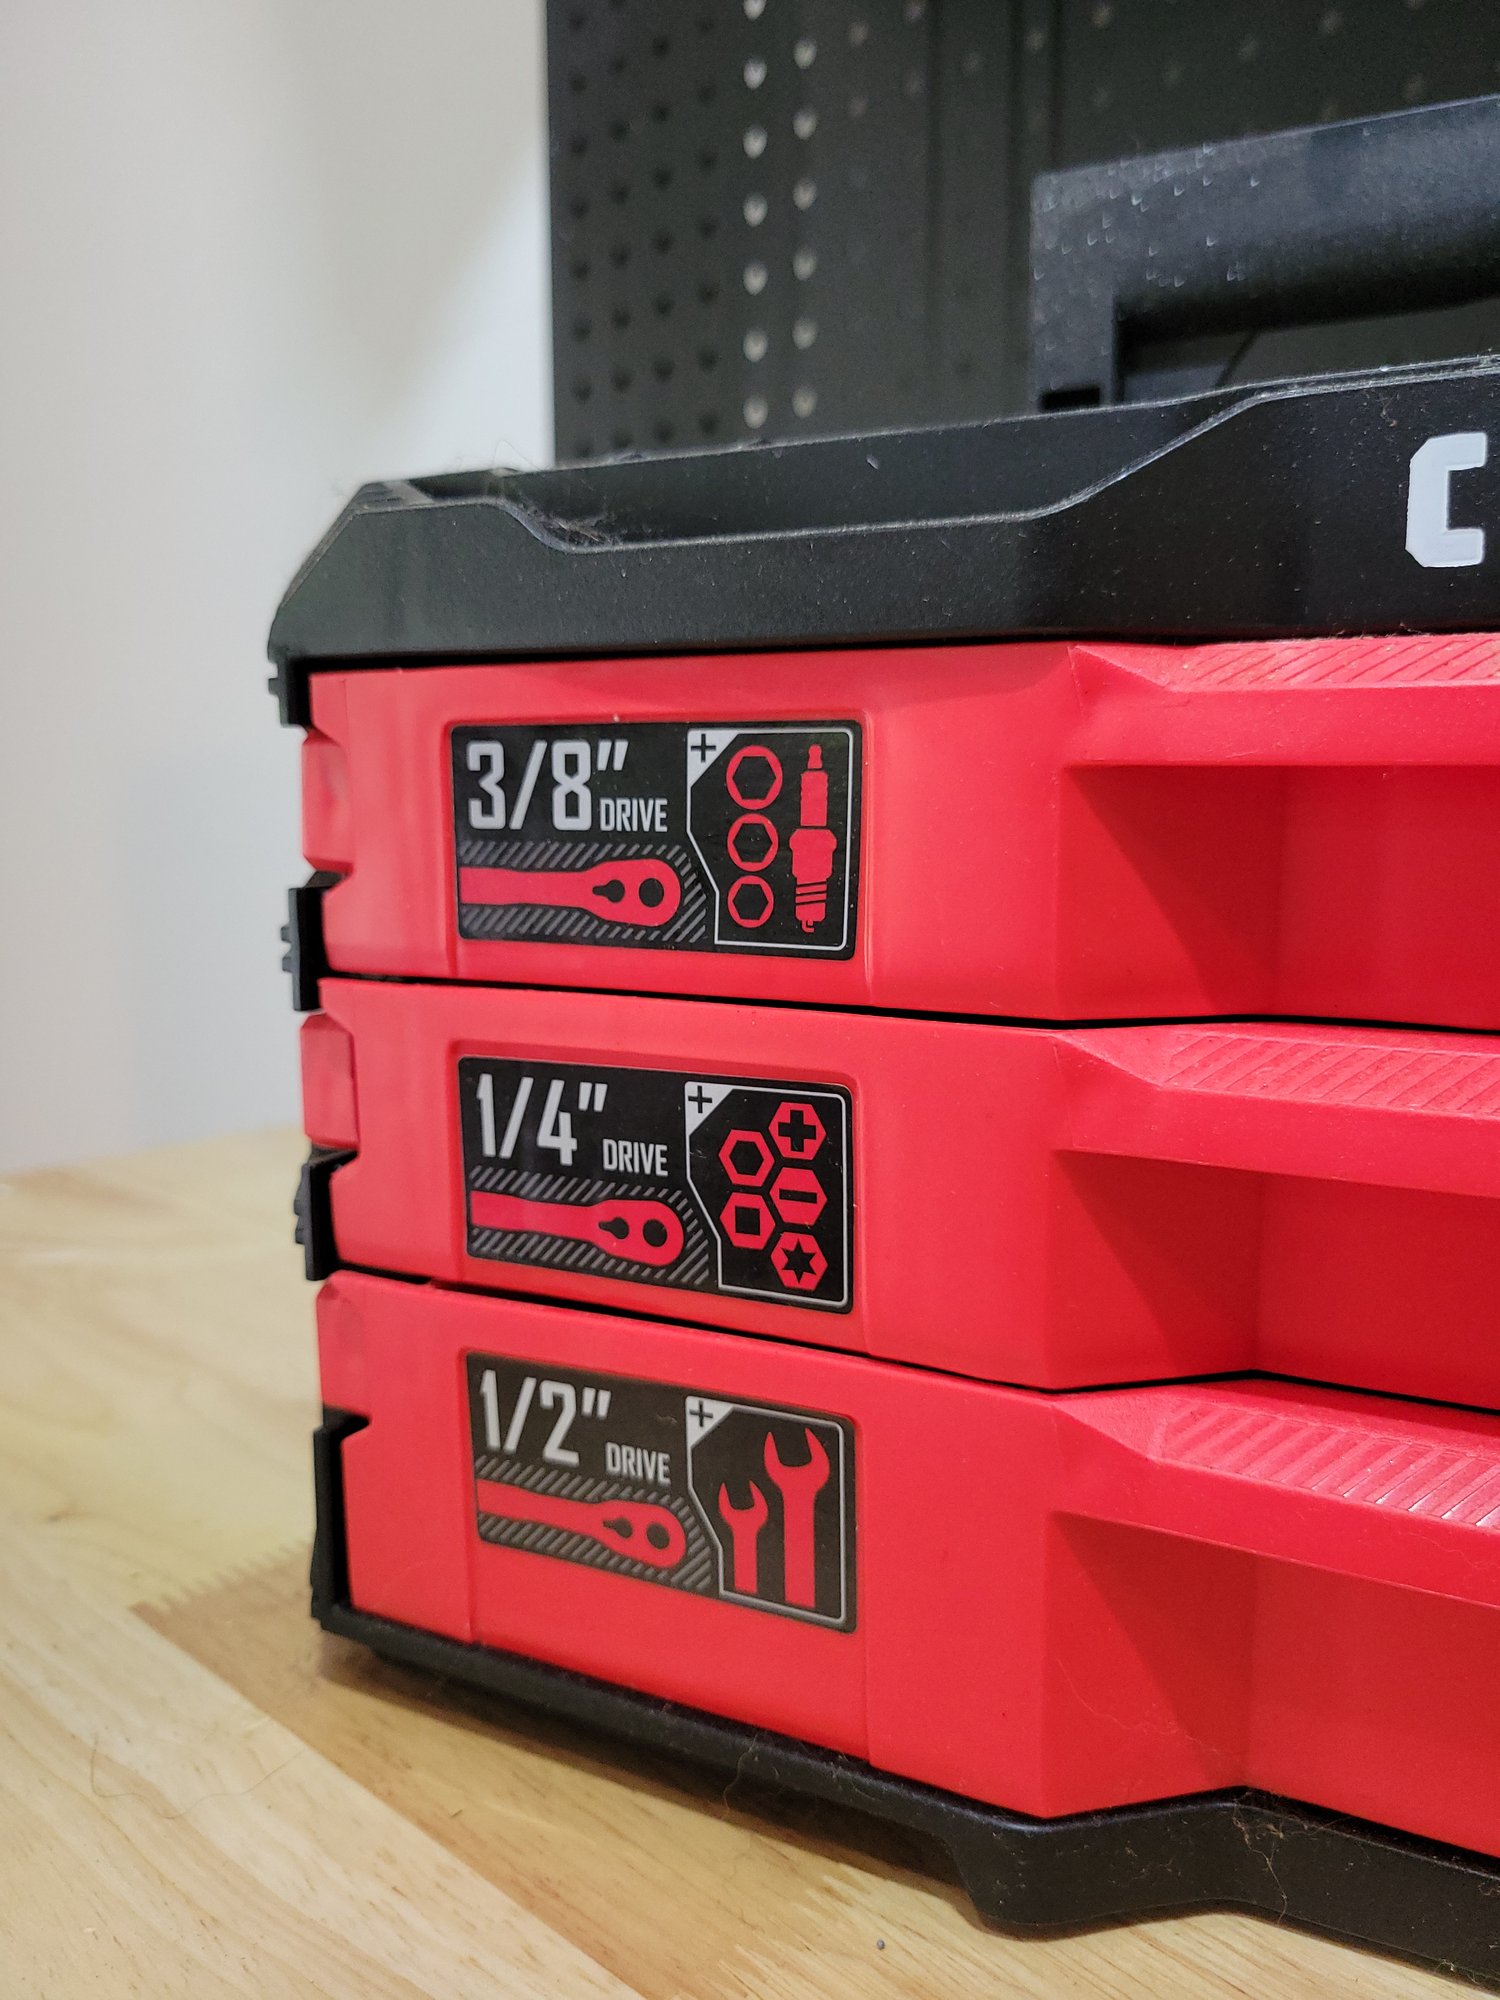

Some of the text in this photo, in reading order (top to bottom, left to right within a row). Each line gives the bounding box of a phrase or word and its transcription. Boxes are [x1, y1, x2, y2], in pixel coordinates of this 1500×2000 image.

[1405, 431, 1488, 568] C
[466, 739, 668, 833] 3/8" DRIVE
[476, 1073, 669, 1177] 1/4" DRIVE
[480, 1369, 672, 1486] 1/2" DRIVE
